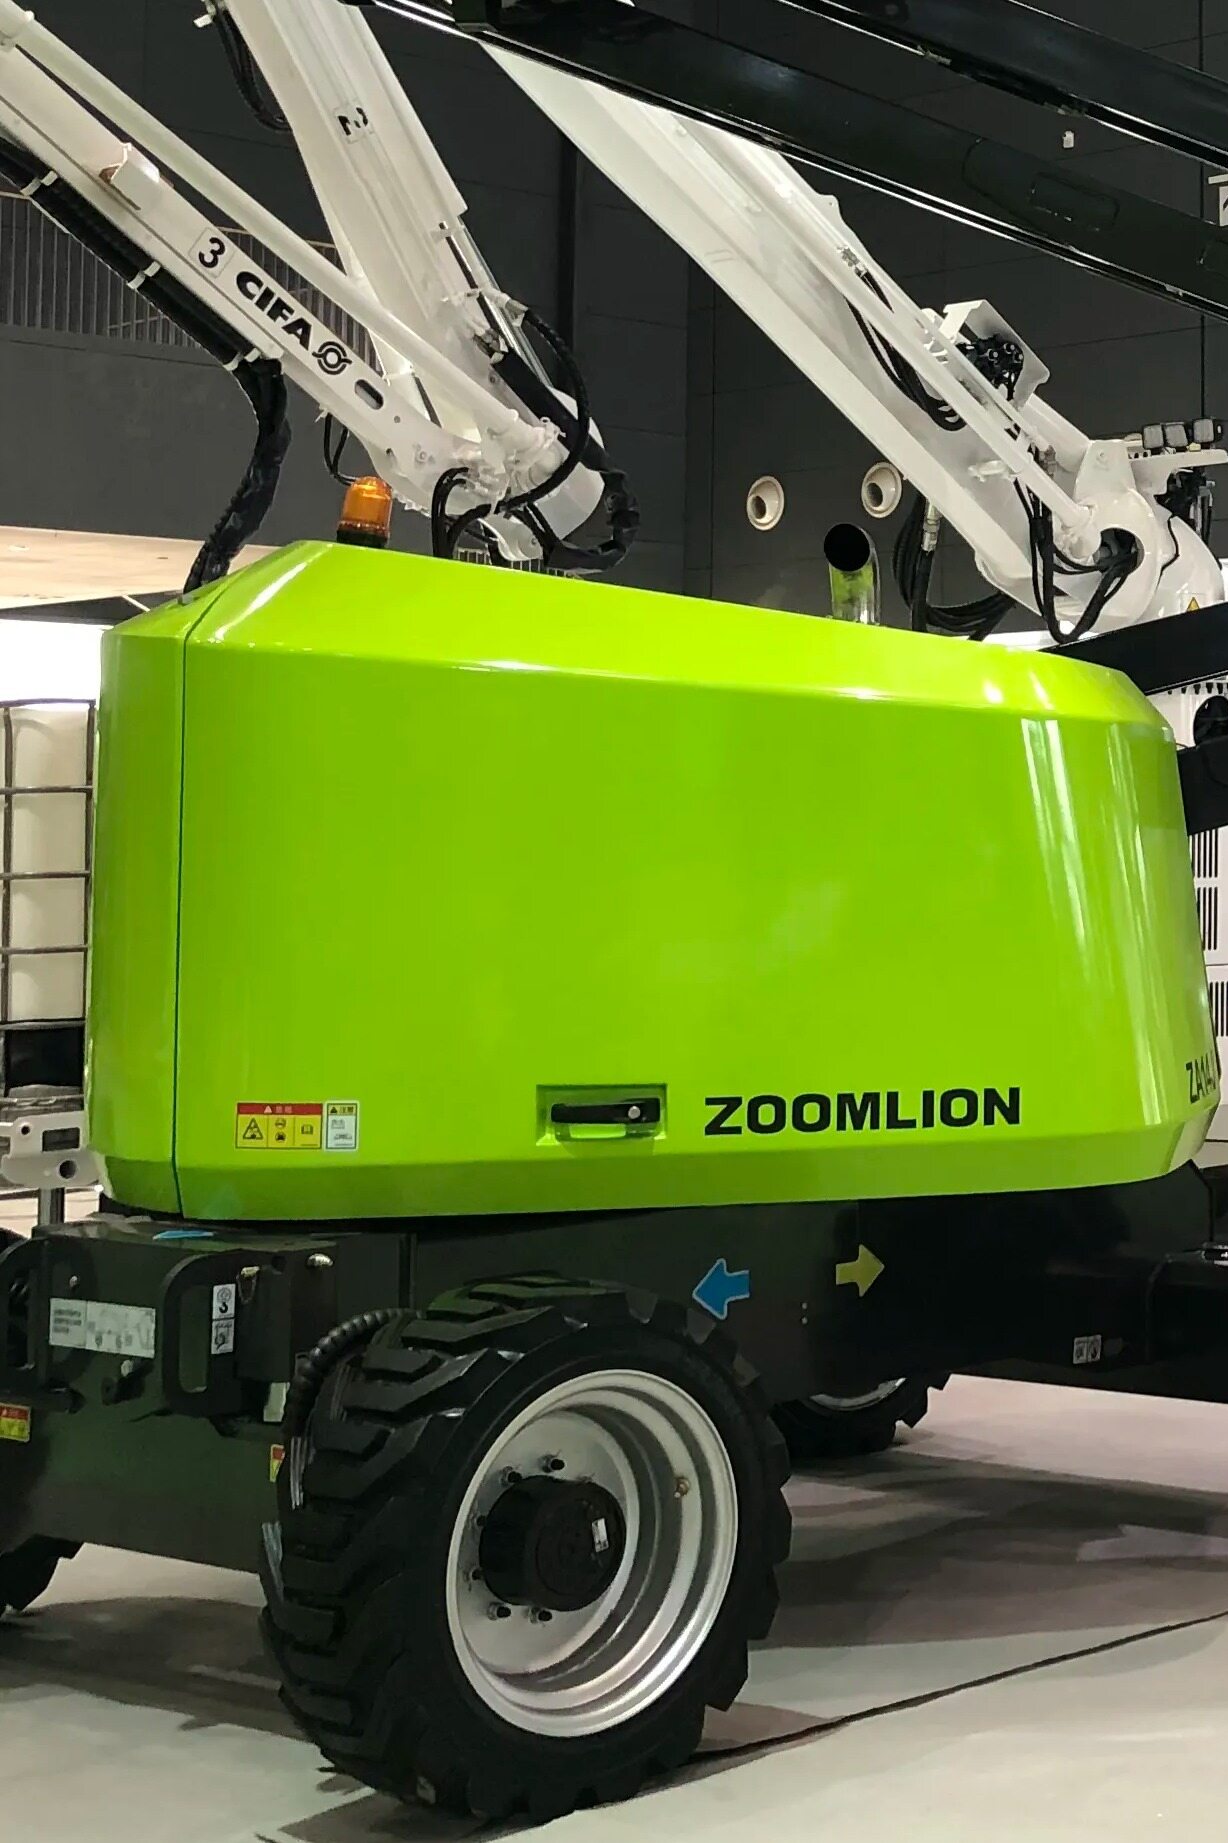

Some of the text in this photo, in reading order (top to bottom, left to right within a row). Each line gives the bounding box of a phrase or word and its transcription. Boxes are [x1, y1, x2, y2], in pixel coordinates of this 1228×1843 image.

[199, 237, 226, 268] 3
[236, 271, 312, 351] CIFA
[704, 1087, 1020, 1136] ZOOMLION
